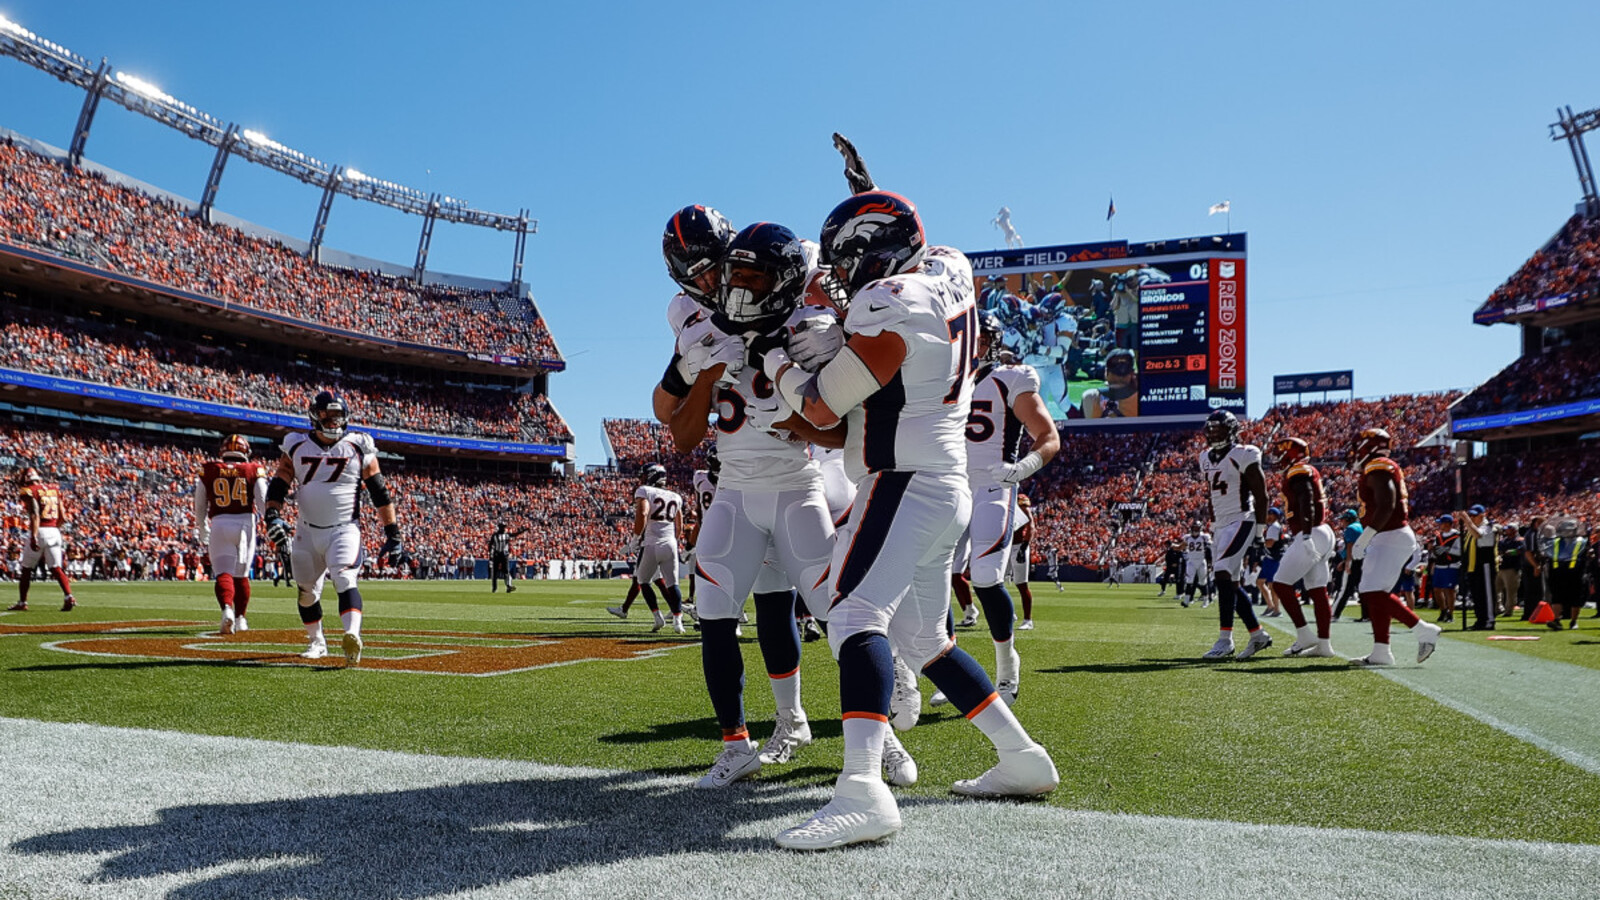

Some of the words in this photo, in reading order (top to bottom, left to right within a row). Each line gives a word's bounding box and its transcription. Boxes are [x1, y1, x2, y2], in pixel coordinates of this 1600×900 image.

[970, 256, 1004, 269] WER
[1023, 252, 1067, 266] FIELD
[1140, 293, 1185, 304] BRONCOS
[1219, 281, 1236, 325] RED
[1145, 360, 1164, 369] 2ND
[1165, 360, 1172, 369] &
[1173, 359, 1180, 368] 3
[1219, 328, 1236, 389] ZONE
[1140, 393, 1188, 401] AIRLINES
[1149, 387, 1187, 395] UNITED
[1222, 397, 1245, 407] bank
[301, 456, 349, 485] 77
[213, 477, 248, 507] 94
[650, 497, 678, 522] 20
[1188, 541, 1202, 552] 82
